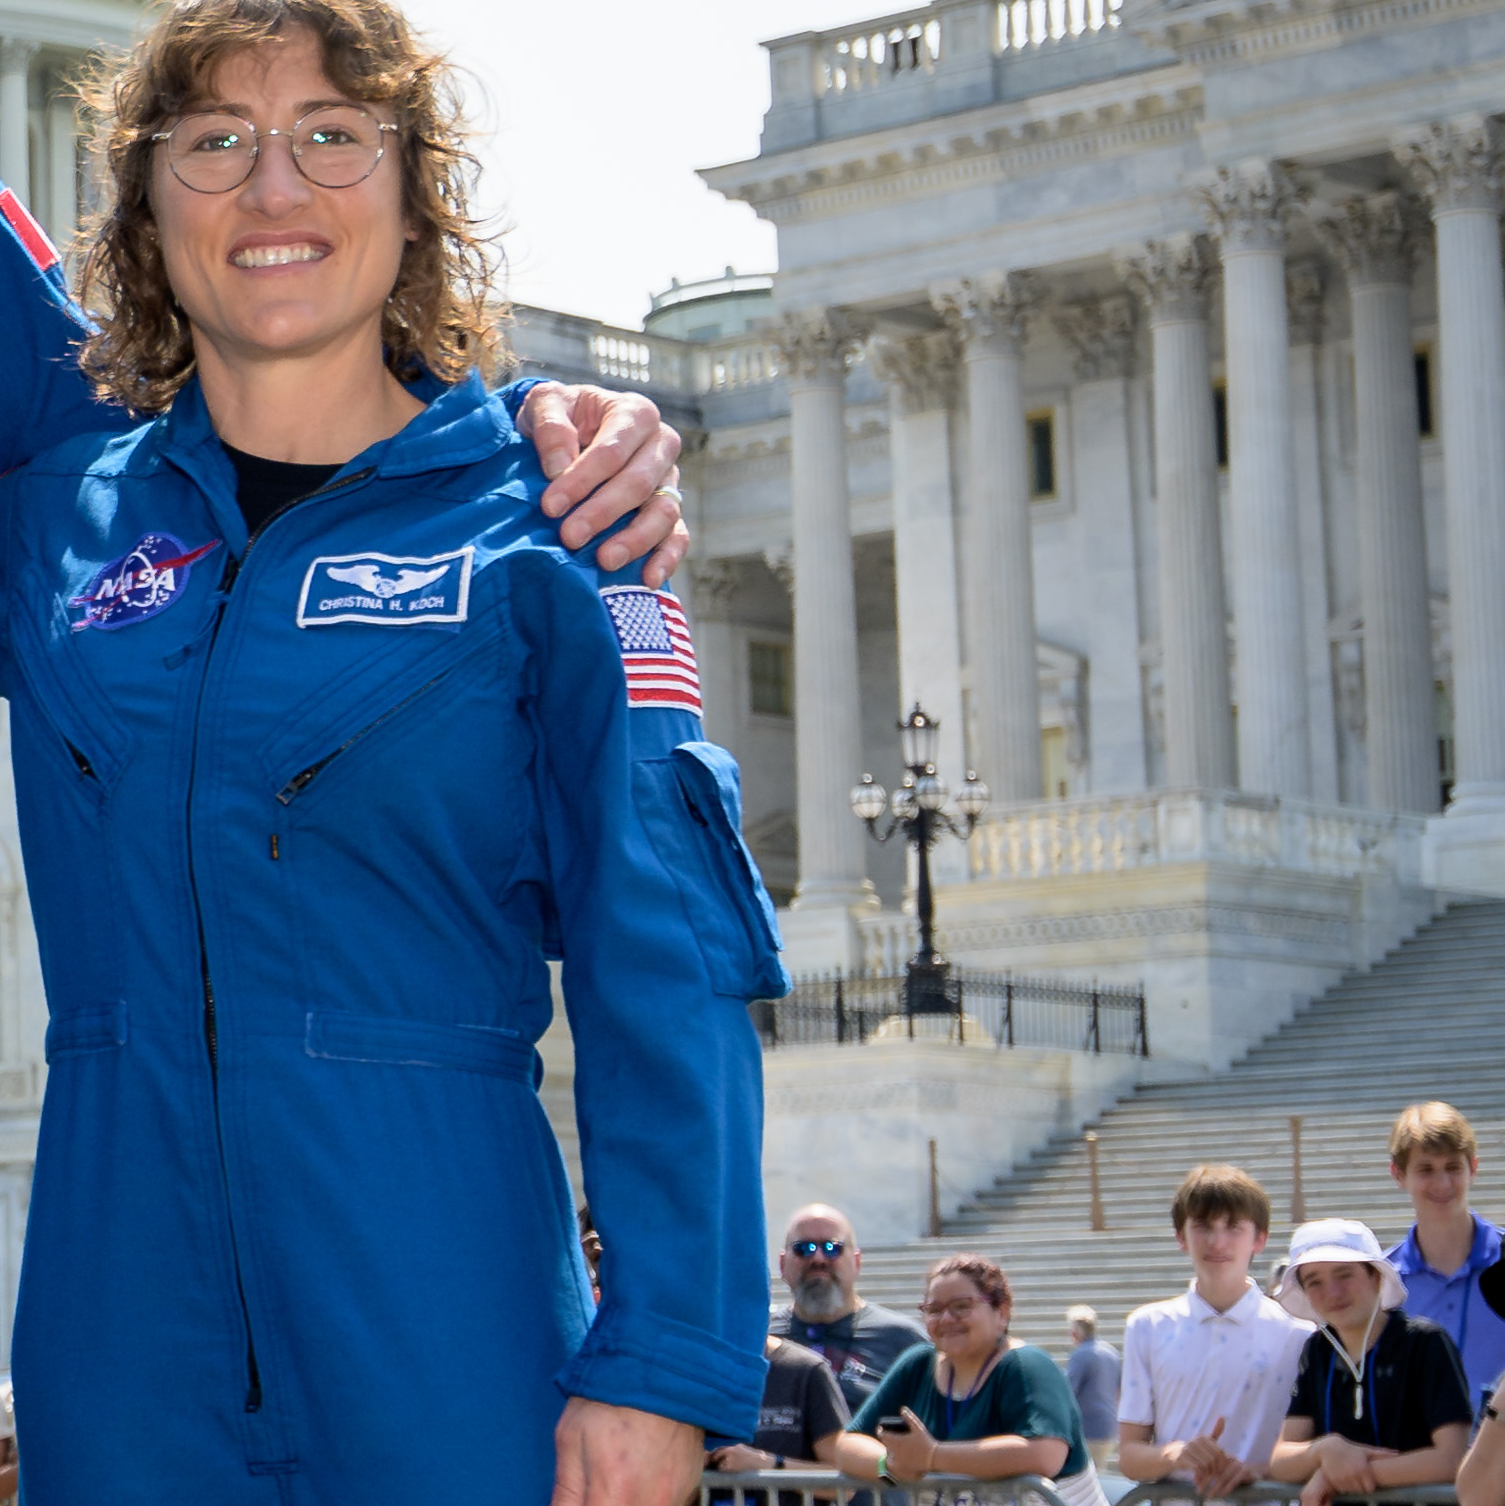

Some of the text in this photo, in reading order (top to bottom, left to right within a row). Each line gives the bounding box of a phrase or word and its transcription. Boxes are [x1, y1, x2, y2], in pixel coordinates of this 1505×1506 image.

[318, 596, 446, 612] CHRISTINA H. KOCH
